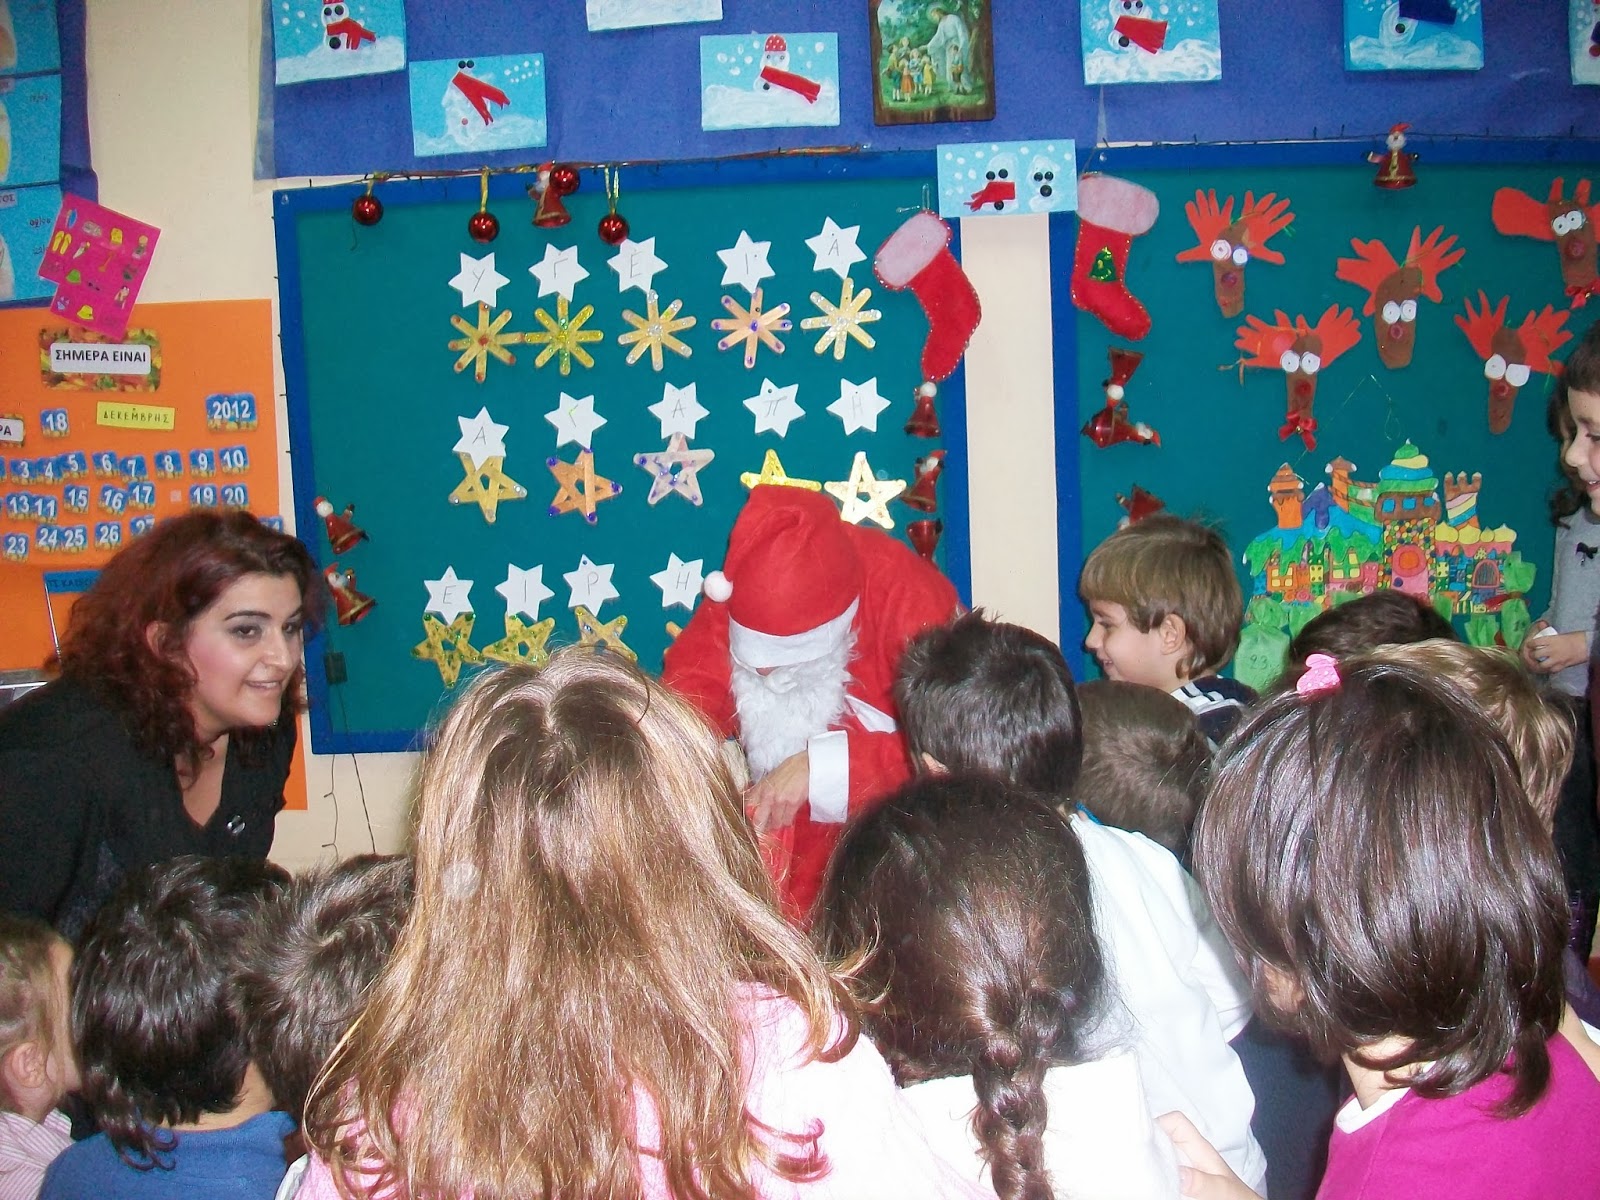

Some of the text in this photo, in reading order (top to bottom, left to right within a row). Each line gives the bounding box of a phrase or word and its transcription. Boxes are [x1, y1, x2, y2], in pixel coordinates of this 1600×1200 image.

[55, 349, 146, 363] ΣΗΜΕΡΑ ΕΙΝΑΙ
[46, 412, 68, 431] 18
[103, 409, 170, 424] ΔΕΚΕΜΒΡΗΣ
[212, 400, 251, 419] 2012
[20, 449, 244, 479] 3 4 5 6 7 8 9 10
[10, 485, 245, 517] 13 11 15 16 17 19 20
[7, 536, 26, 554] 23
[39, 527, 58, 548] 24
[64, 528, 85, 547] 25
[100, 525, 119, 543] 26
